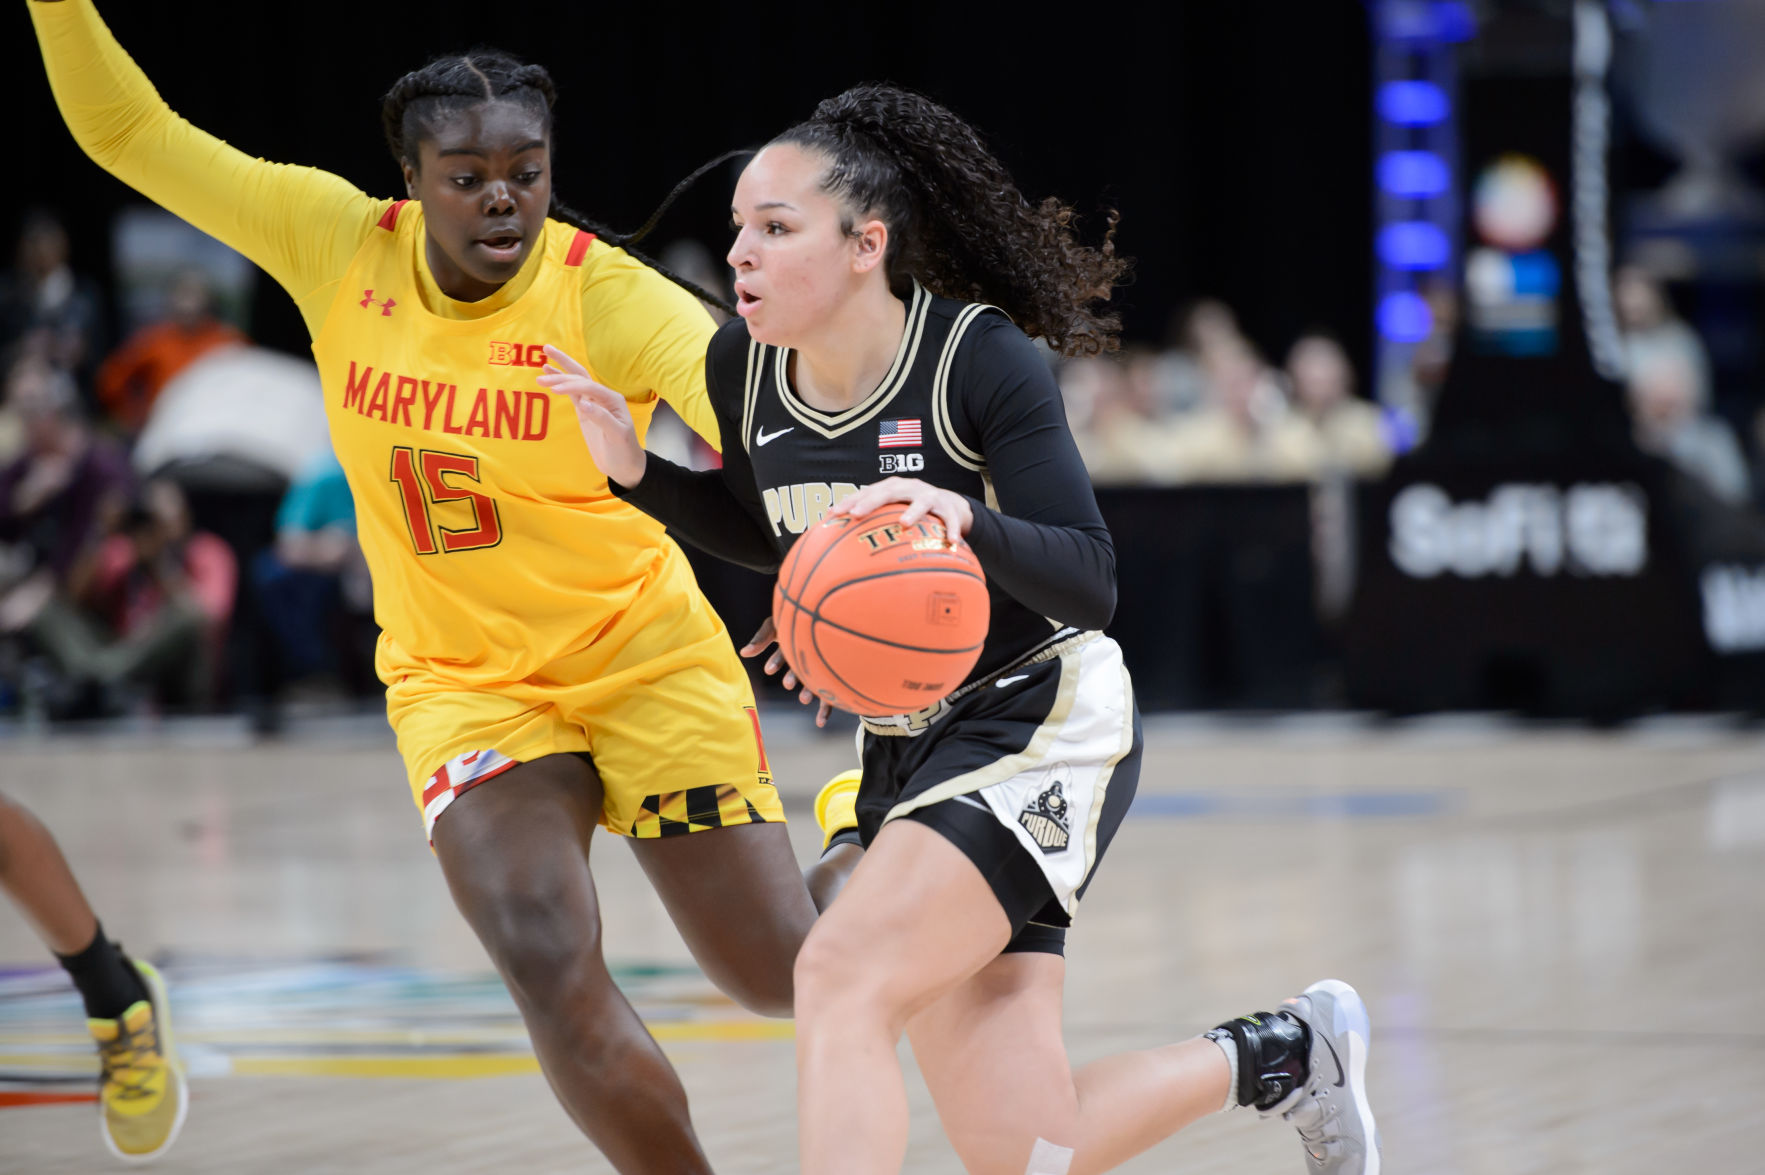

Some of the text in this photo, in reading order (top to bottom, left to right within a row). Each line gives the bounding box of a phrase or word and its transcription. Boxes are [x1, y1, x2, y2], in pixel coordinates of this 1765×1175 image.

[342, 360, 551, 441] MARYLAND
[390, 445, 503, 555] 15
[1020, 811, 1069, 849] PURDUE
